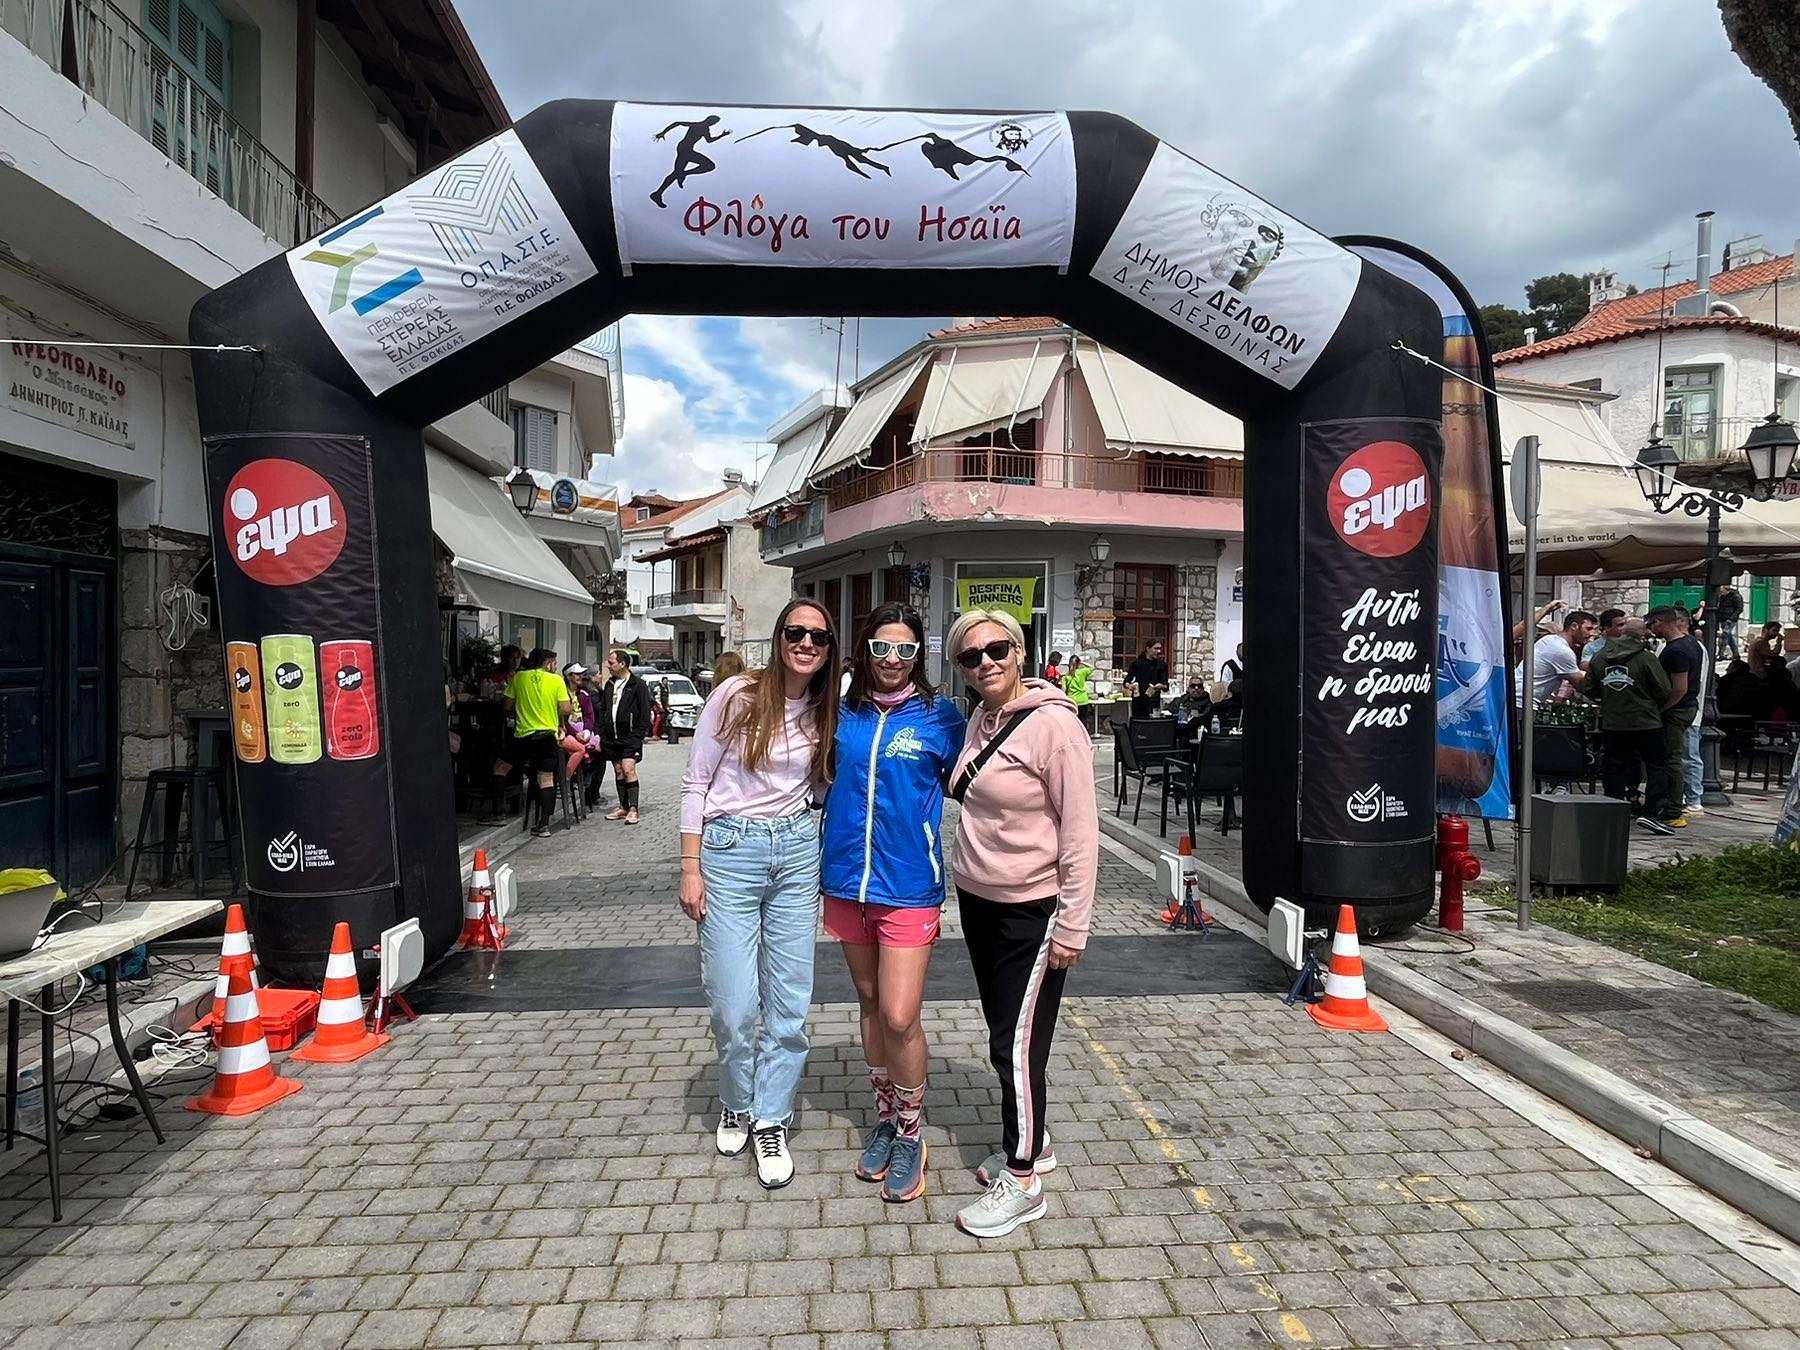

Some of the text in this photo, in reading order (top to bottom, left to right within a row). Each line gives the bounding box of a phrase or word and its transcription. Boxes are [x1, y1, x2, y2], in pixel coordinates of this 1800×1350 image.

[832, 214, 890, 240] του
[515, 271, 566, 304] ΦΩΚΙΔΑΣ
[1124, 242, 1306, 355] ΔΗΜΟΣ ΔΕΛΦΩΝ
[367, 292, 438, 336] ΠΕΡΙΦΕΡΕΙΑ
[376, 306, 449, 350] ΣΤΕΡΕΑΣ
[386, 319, 457, 363] ΕΛΛΑΔΑΣ
[421, 334, 466, 364] ΦΩΚΙΔΑΣ
[1169, 298, 1288, 374] ΔΕΣΦΙΝΑΣ
[11, 336, 126, 397] ΚΡΕΟΠΩΛΕΙΟ
[9, 382, 75, 417] ΔΗΜΗΤΡΙΟΣ
[1553, 535, 1564, 543] in
[1567, 534, 1584, 542] the
[969, 584, 1022, 595] DESFINA
[969, 593, 1023, 607] RUNNERS
[1340, 587, 1420, 631] Αυτή
[1318, 664, 1431, 703] η δροσιά
[1346, 703, 1412, 735] μας
